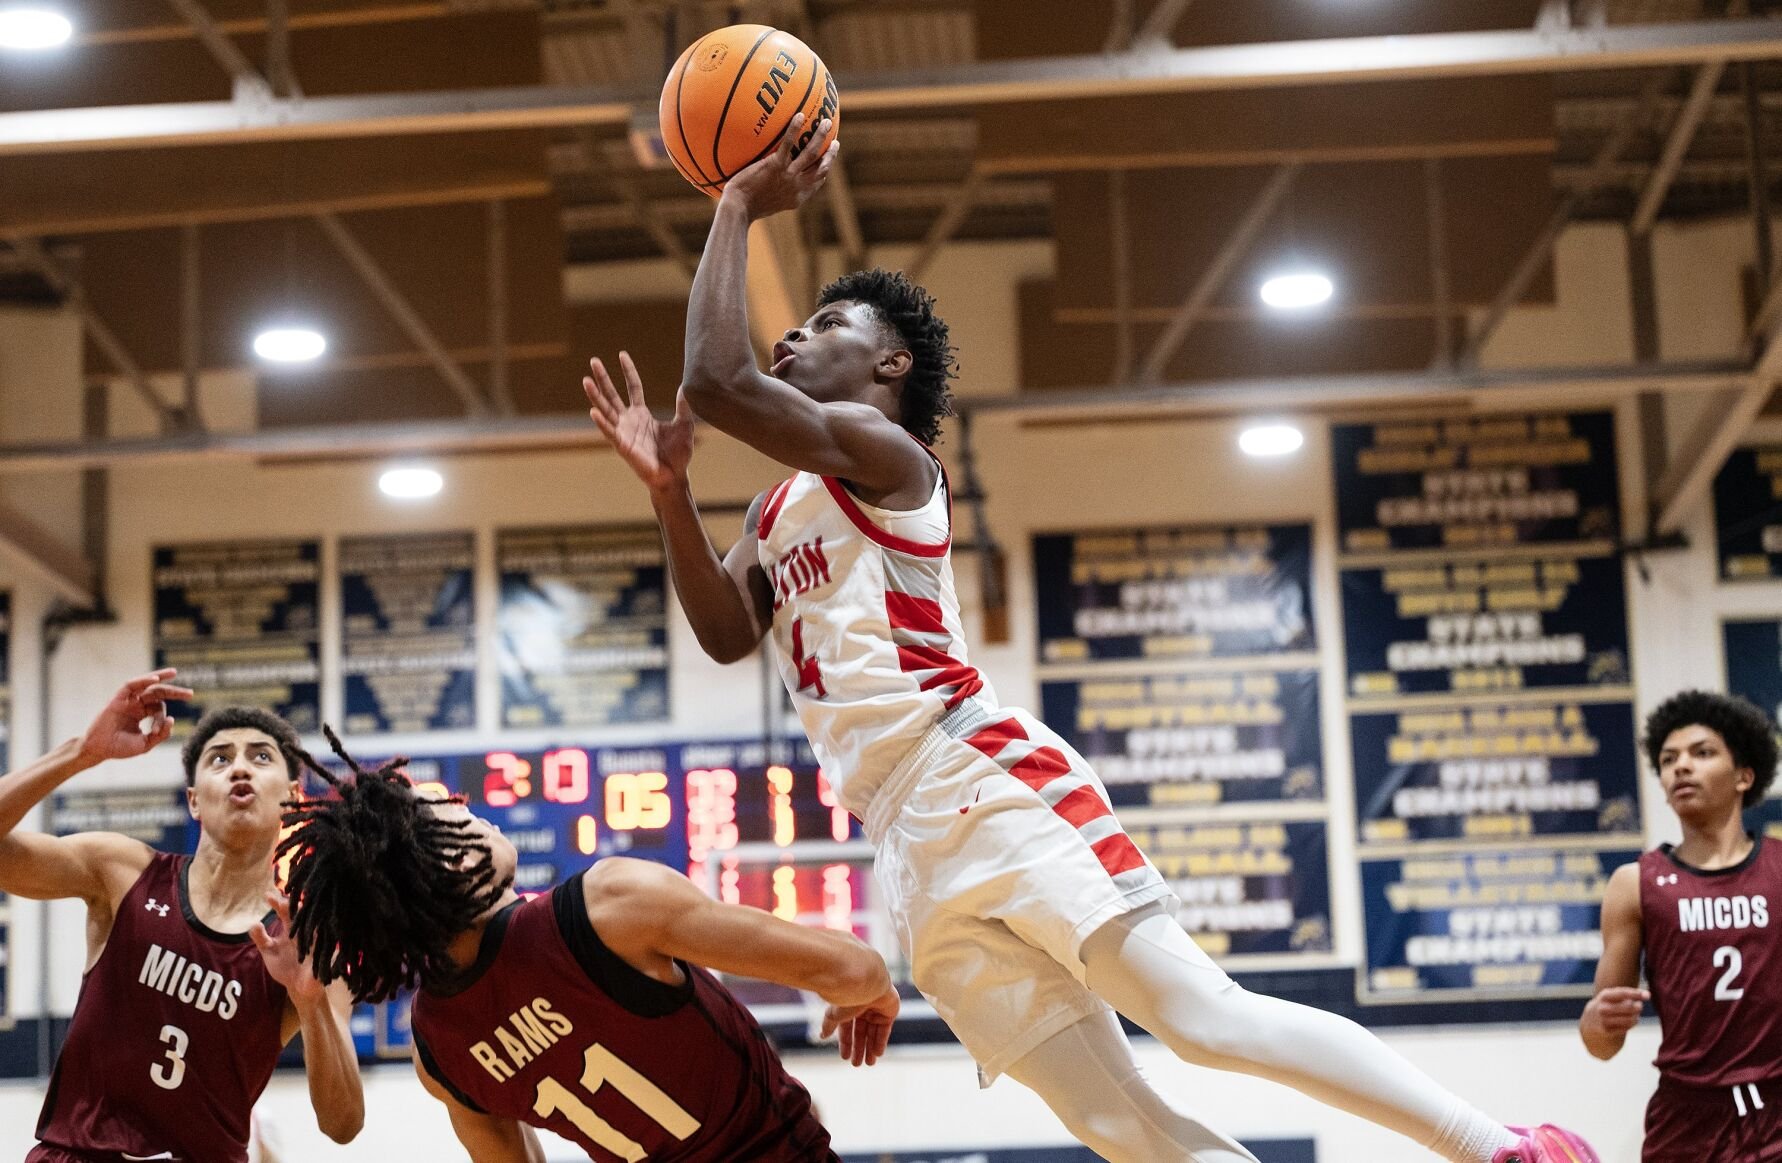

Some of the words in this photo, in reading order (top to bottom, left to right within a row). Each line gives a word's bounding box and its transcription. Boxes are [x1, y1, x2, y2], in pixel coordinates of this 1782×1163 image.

[755, 51, 798, 115] EVO
[792, 615, 828, 699] 4
[1678, 895, 1769, 932] MICDS
[138, 944, 243, 1021] MICDS
[1713, 946, 1744, 1001] 2
[150, 1025, 189, 1090] 3
[469, 997, 573, 1083] RAMS
[533, 1042, 701, 1163] 11
